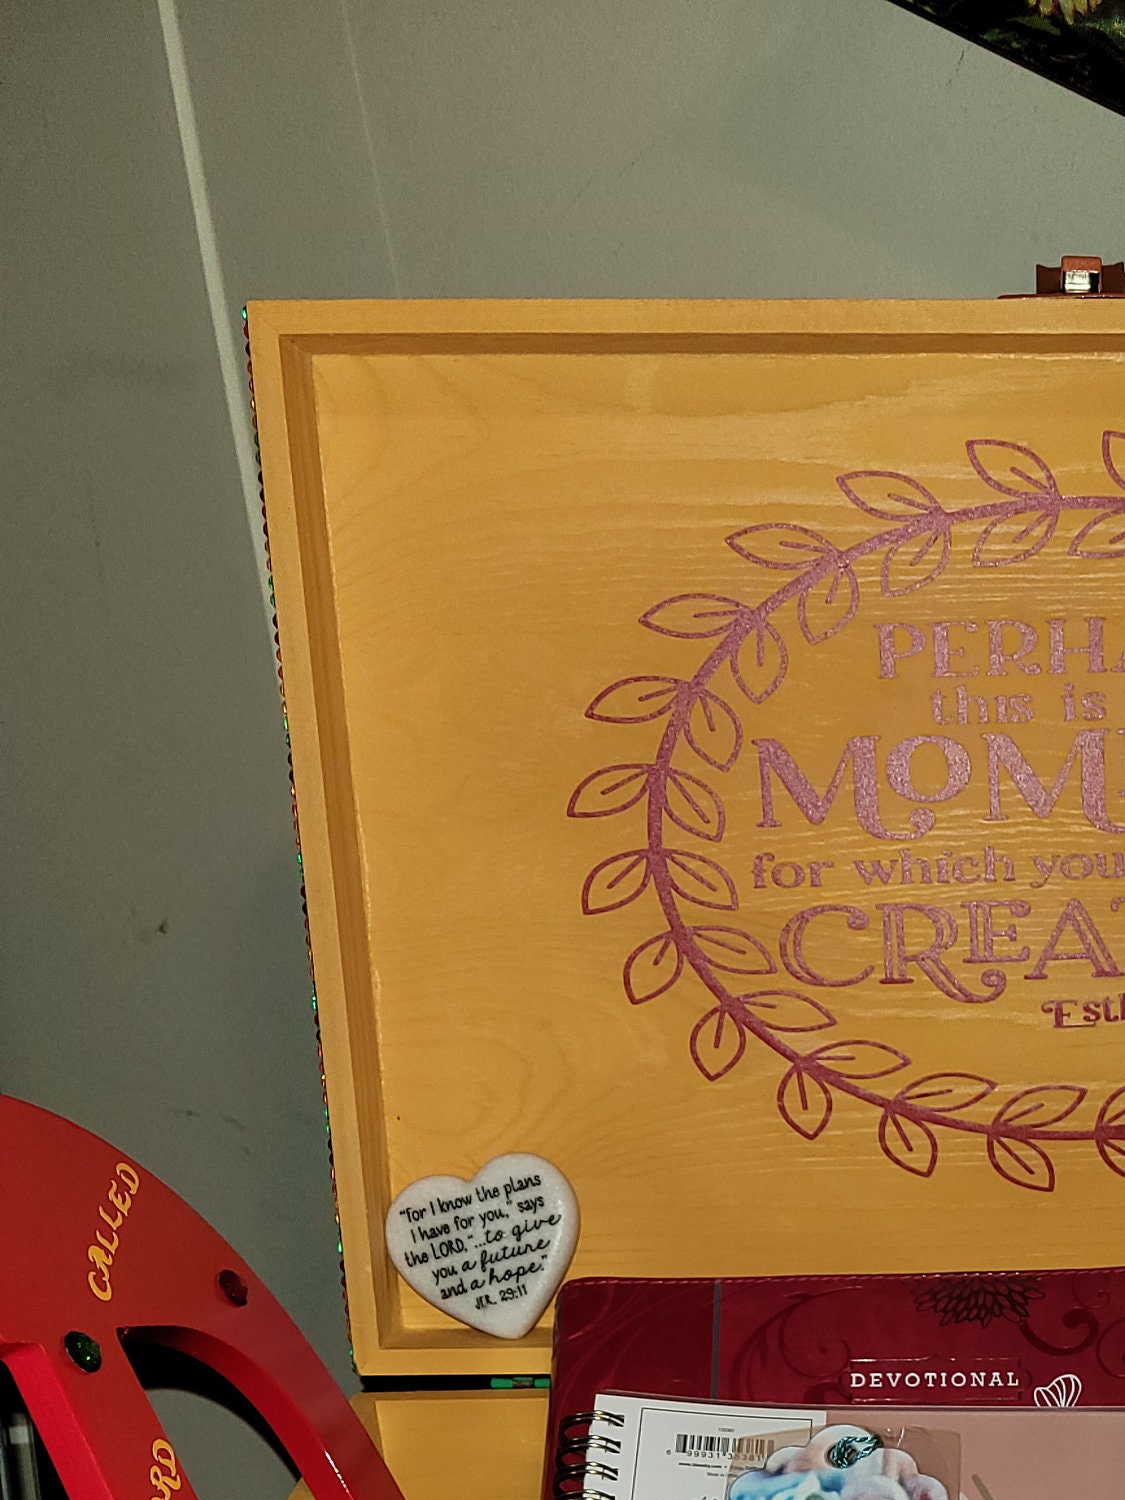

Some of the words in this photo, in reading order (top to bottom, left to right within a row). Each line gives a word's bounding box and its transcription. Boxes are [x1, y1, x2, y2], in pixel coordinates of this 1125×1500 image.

[930, 684, 1034, 725] this
[1062, 682, 1106, 722] is
[752, 852, 834, 888] for
[852, 845, 1015, 885] which
[1029, 851, 1125, 888] you
[430, 1201, 436, 1215] I
[438, 1193, 473, 1213] know
[476, 1187, 500, 1203] the
[504, 1174, 542, 1199] plans
[88, 1163, 139, 1301] CALLED
[405, 1251, 428, 1267] the
[512, 1214, 562, 1241] give
[410, 1230, 416, 1243] I
[419, 1222, 450, 1241] have
[454, 1216, 474, 1232] for
[518, 1195, 545, 1217] says
[432, 1263, 458, 1286] you
[462, 1259, 477, 1272] a
[480, 1239, 550, 1272] future
[441, 1278, 467, 1300] and
[471, 1279, 486, 1290] a
[499, 1284, 527, 1302] 29:11
[850, 1372, 1019, 1388] DEVOTIONAL
